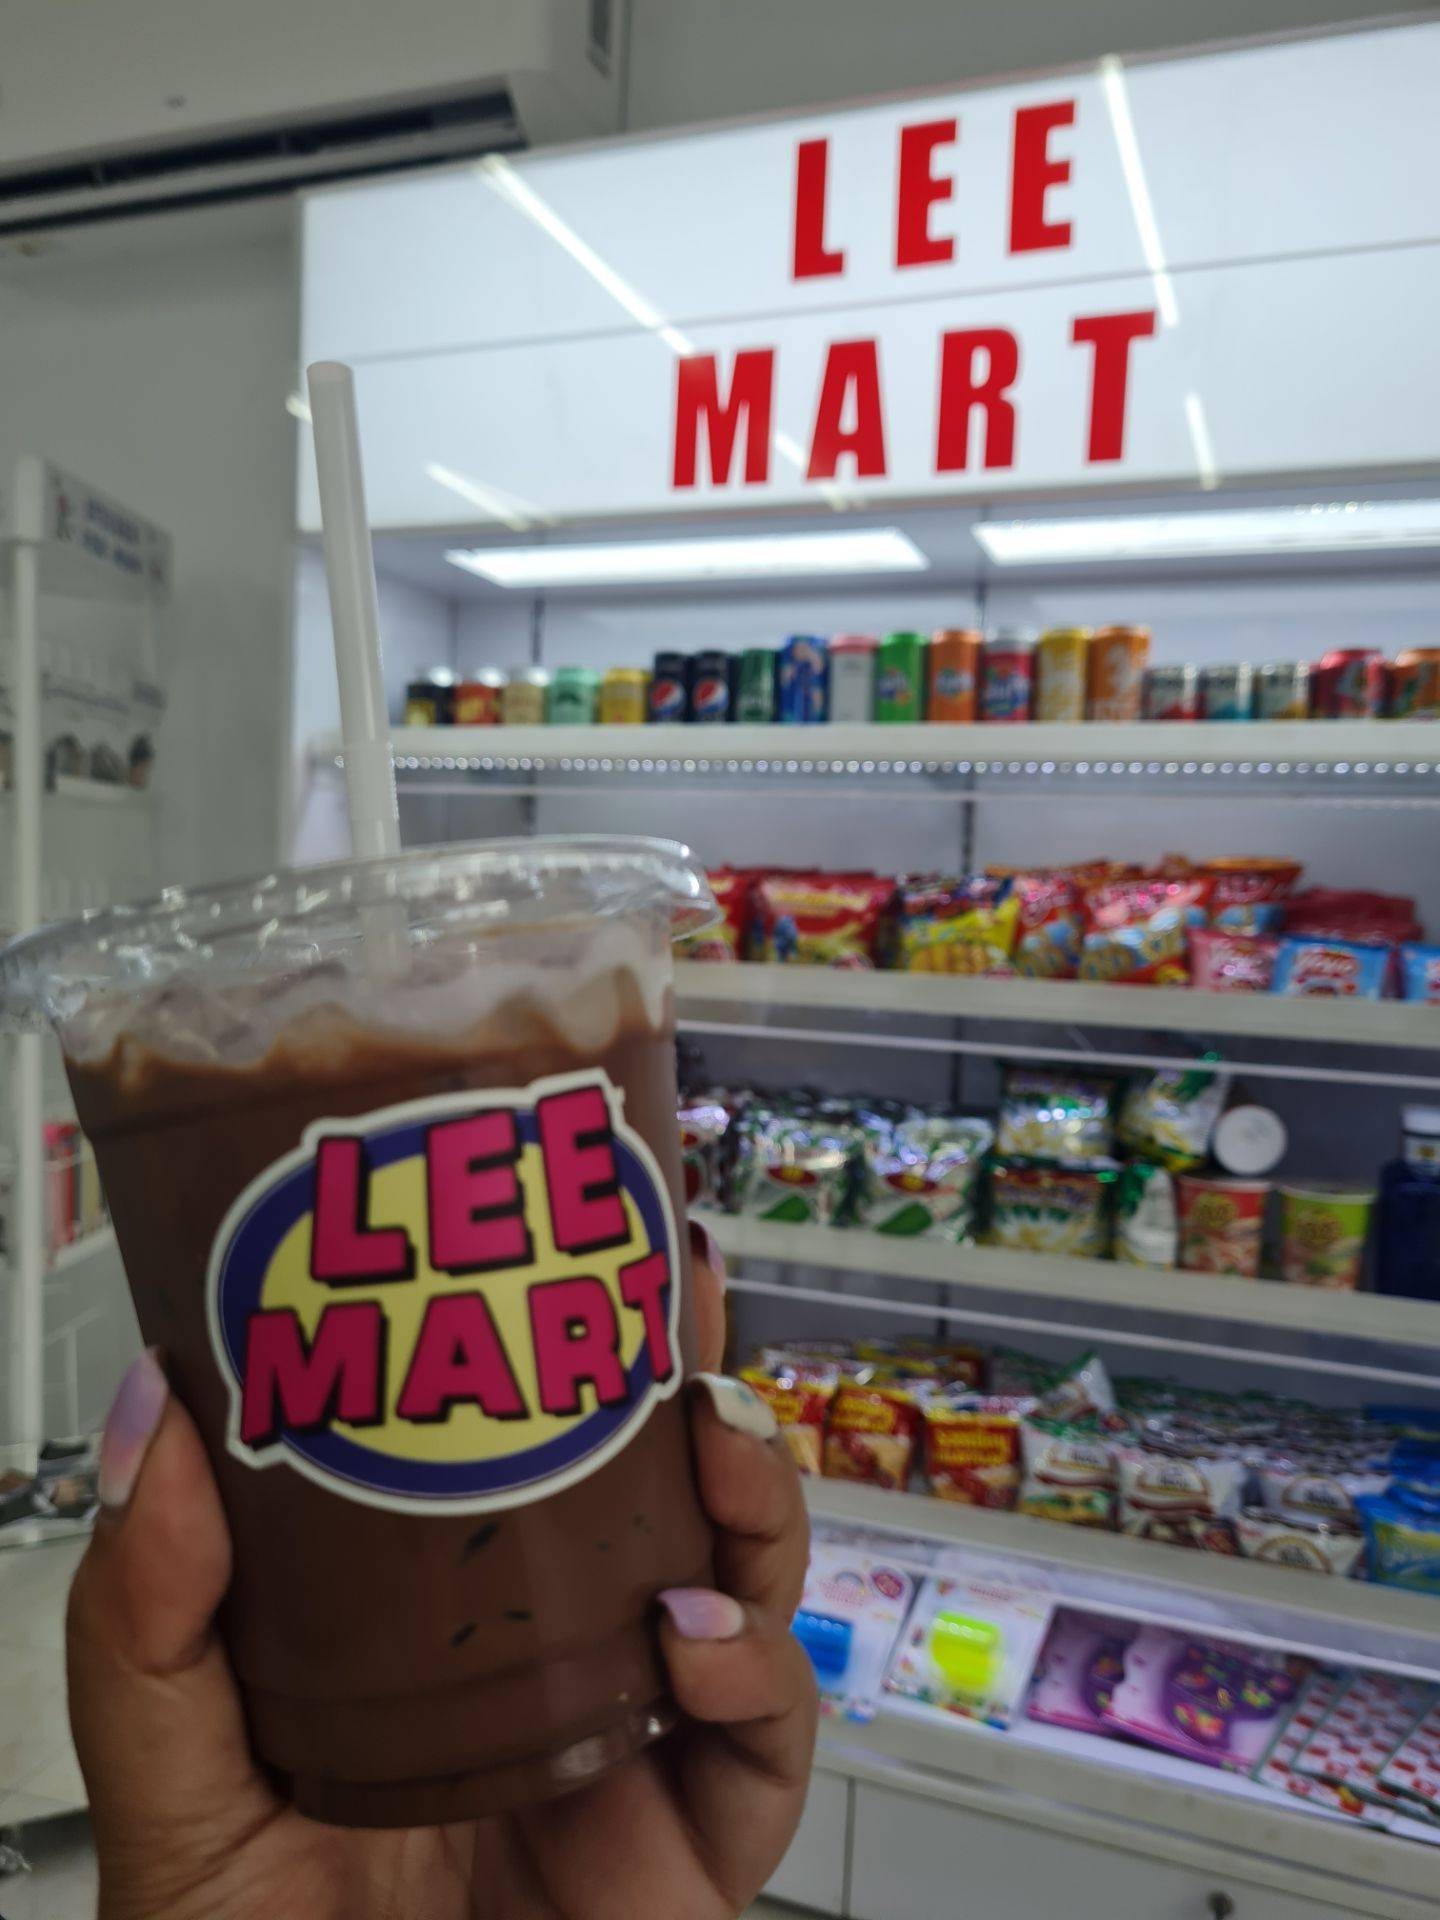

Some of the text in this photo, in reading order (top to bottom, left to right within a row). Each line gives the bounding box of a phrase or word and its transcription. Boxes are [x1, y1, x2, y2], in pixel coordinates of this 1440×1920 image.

[791, 99, 1076, 282] LEE
[672, 309, 1156, 490] MART
[310, 1086, 630, 1287] LEE
[239, 1250, 673, 1450] MART
